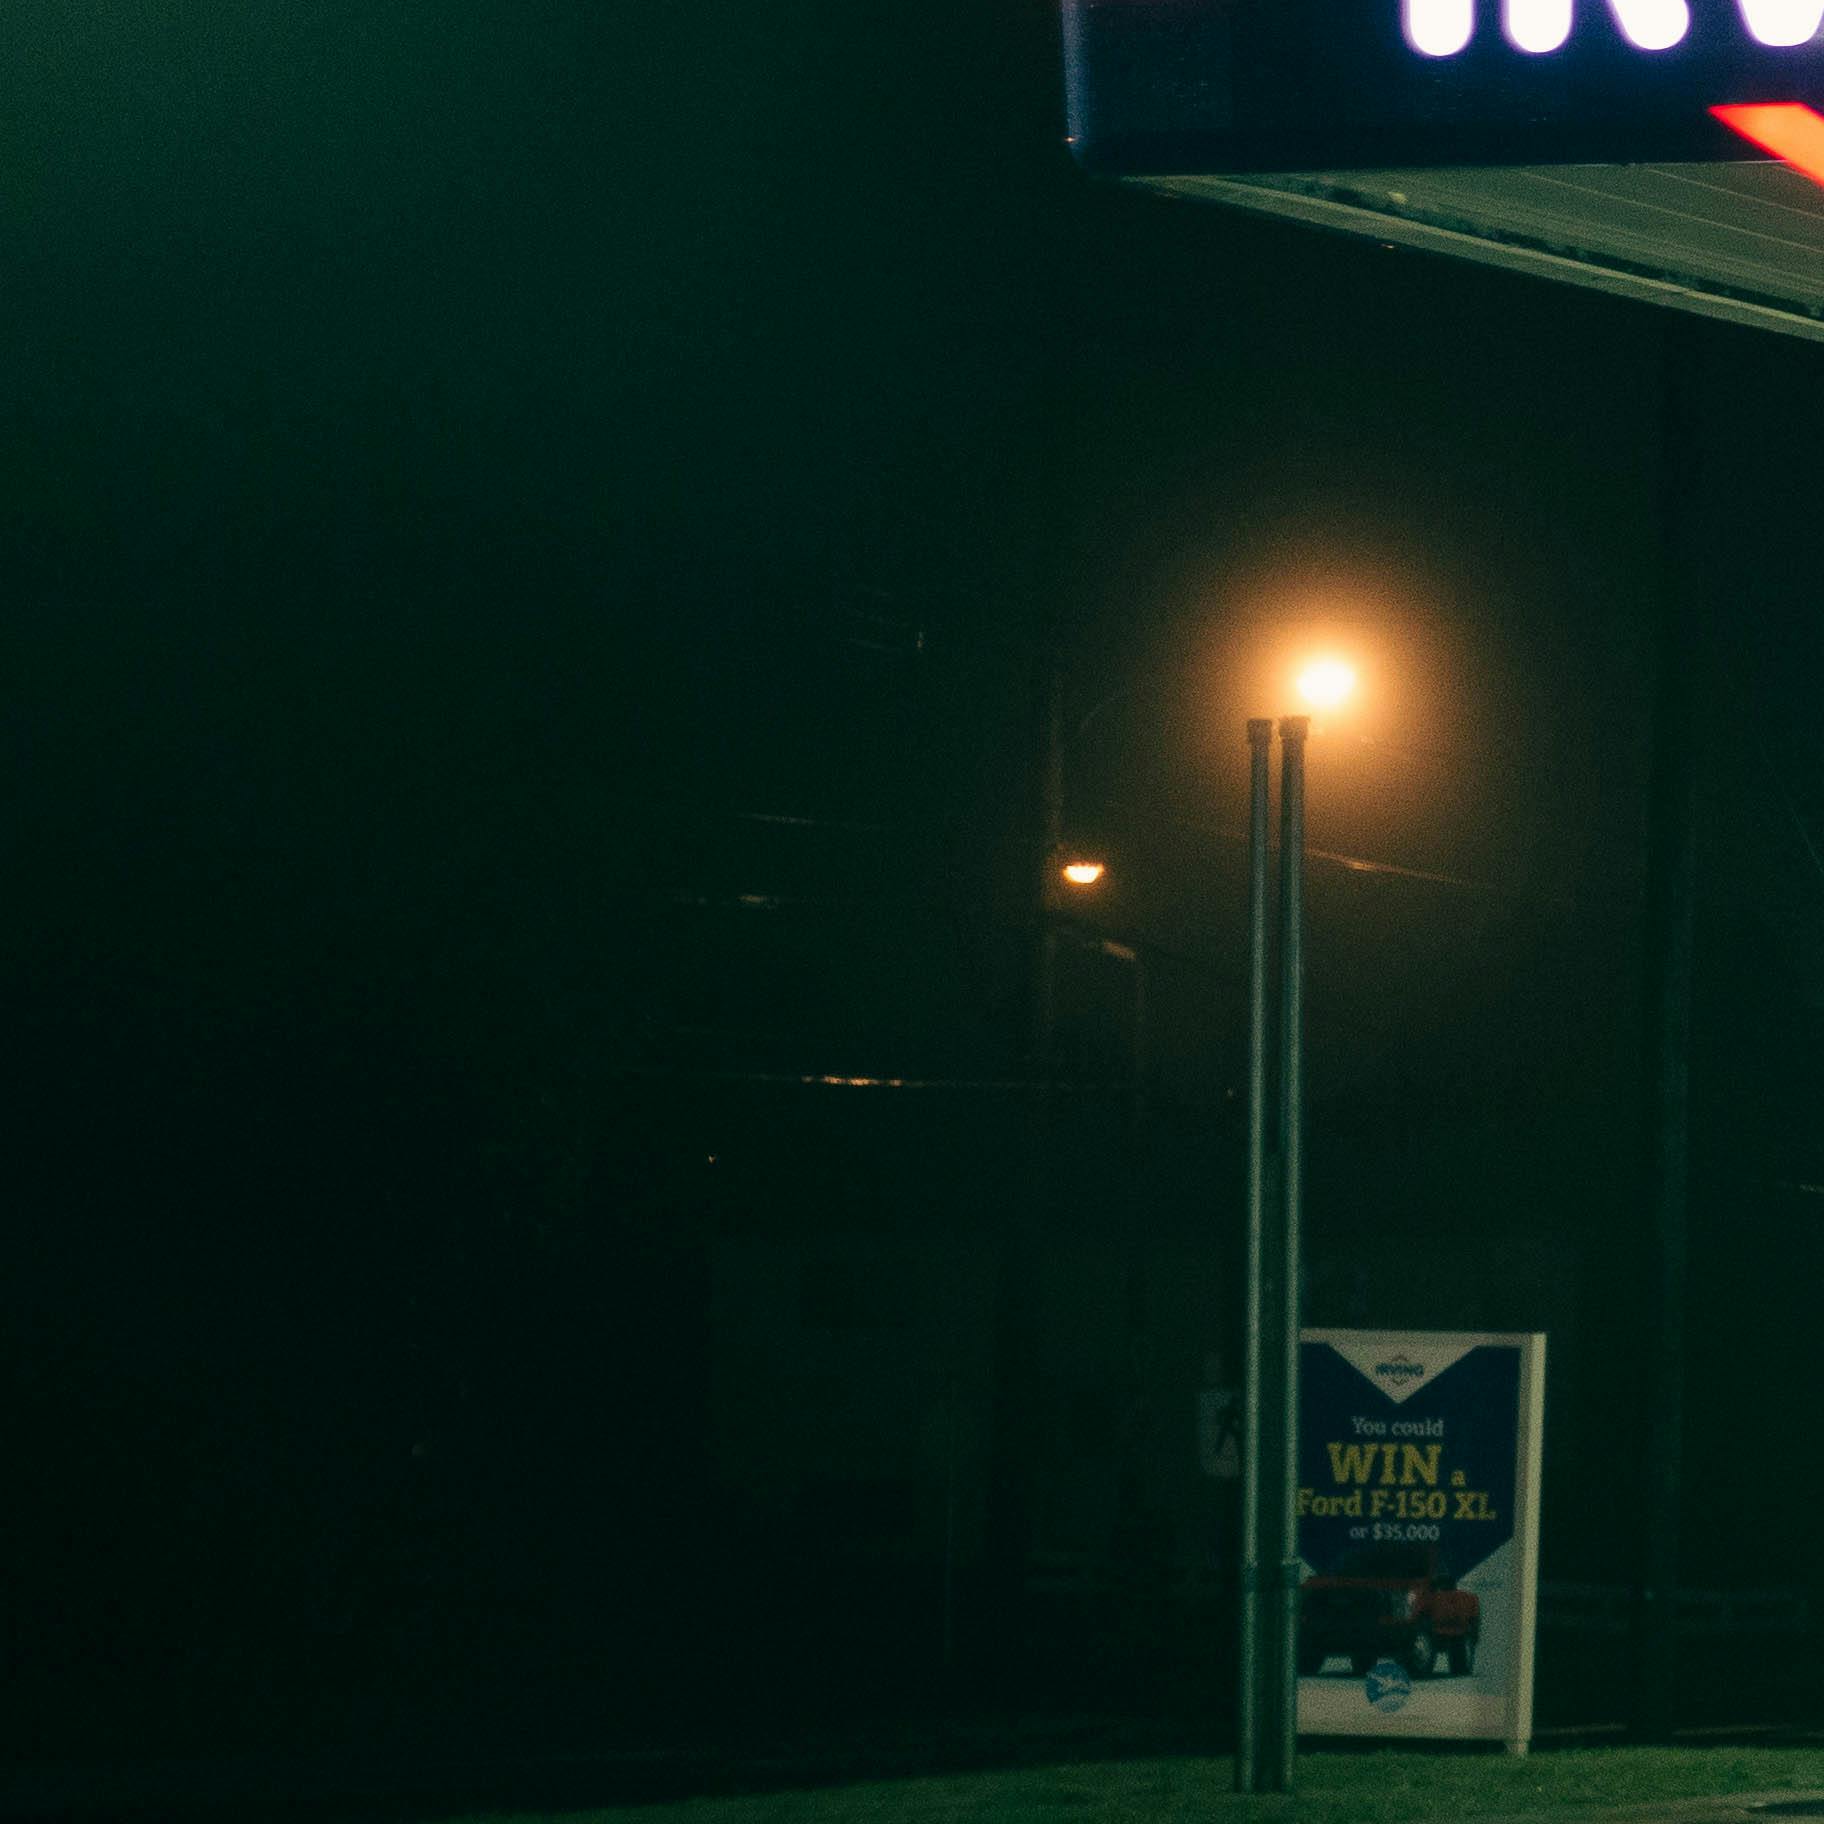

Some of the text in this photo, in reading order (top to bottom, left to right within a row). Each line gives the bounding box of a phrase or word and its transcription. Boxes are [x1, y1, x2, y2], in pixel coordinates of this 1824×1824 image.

[1351, 1416, 1444, 1437] You could
[1327, 1442, 1466, 1487] WIN a
[1296, 1487, 1362, 1517] Ford
[1370, 1489, 1447, 1519] F-150
[1349, 1525, 1369, 1540] or
